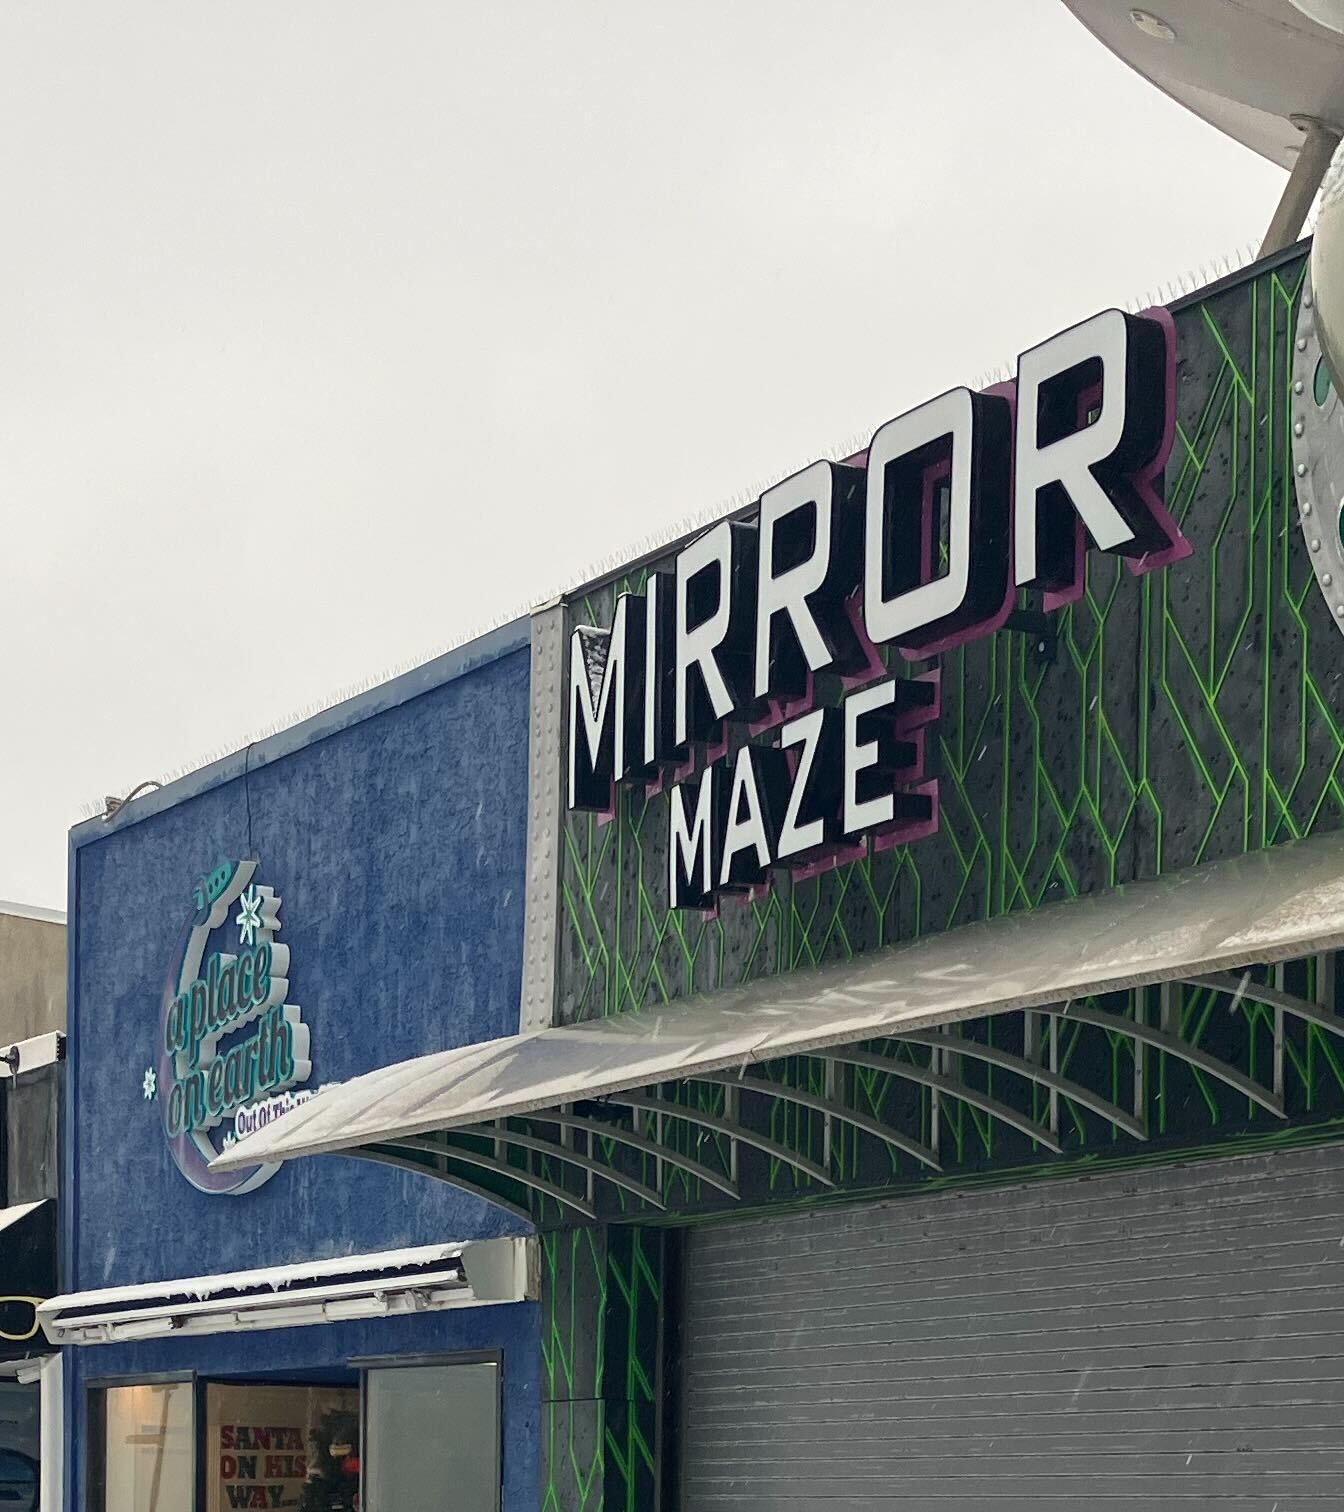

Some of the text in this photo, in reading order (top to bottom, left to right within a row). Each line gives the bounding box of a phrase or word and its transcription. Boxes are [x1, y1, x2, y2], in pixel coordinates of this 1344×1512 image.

[568, 307, 1136, 810] MIRROR
[669, 679, 896, 910] MAZE
[166, 941, 272, 1068] a place
[167, 1003, 294, 1138] on earth
[238, 1110, 256, 1135] Out
[220, 1425, 305, 1450] SANTA
[220, 1455, 308, 1479] ON HIS
